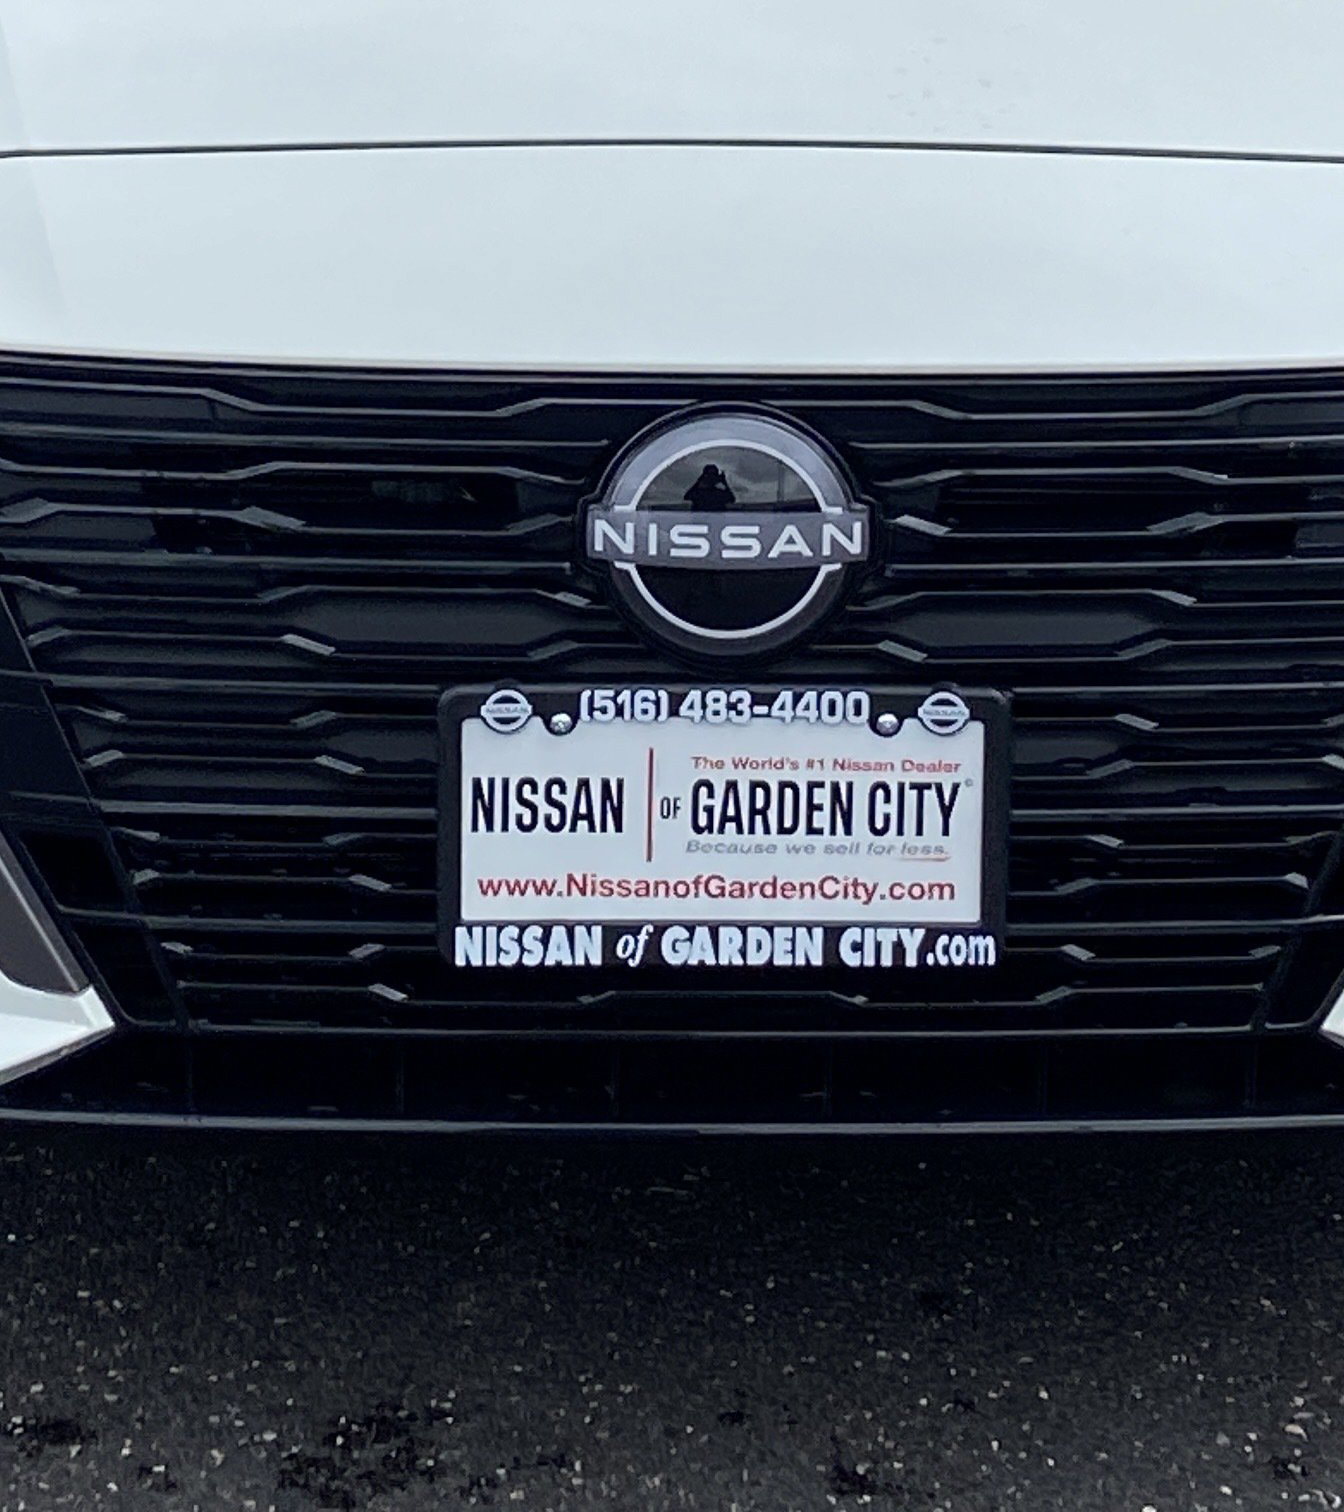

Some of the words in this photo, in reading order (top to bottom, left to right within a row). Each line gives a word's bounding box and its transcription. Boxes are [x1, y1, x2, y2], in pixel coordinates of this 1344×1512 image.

[593, 518, 862, 559] NISSAN
[579, 688, 670, 723] (516)
[678, 688, 872, 725] 483-4400
[691, 755, 726, 770] The
[731, 756, 800, 772] World's
[805, 757, 825, 772] #1
[831, 758, 895, 773] Nissan
[901, 759, 962, 774] Dealer
[470, 776, 625, 834] NISSAN
[659, 796, 682, 820] OF
[690, 778, 854, 836] GARDEN
[867, 780, 962, 838] CITY
[685, 840, 778, 855] Because
[785, 844, 817, 856] we
[823, 841, 860, 856] sell
[866, 842, 896, 857] for
[901, 842, 950, 857] less.
[477, 872, 956, 906] www.NissanofGardenCity.com
[454, 924, 603, 968] NISSAN
[615, 923, 654, 969] of
[660, 924, 824, 968] GARDEN
[837, 926, 997, 969] CITY.com
